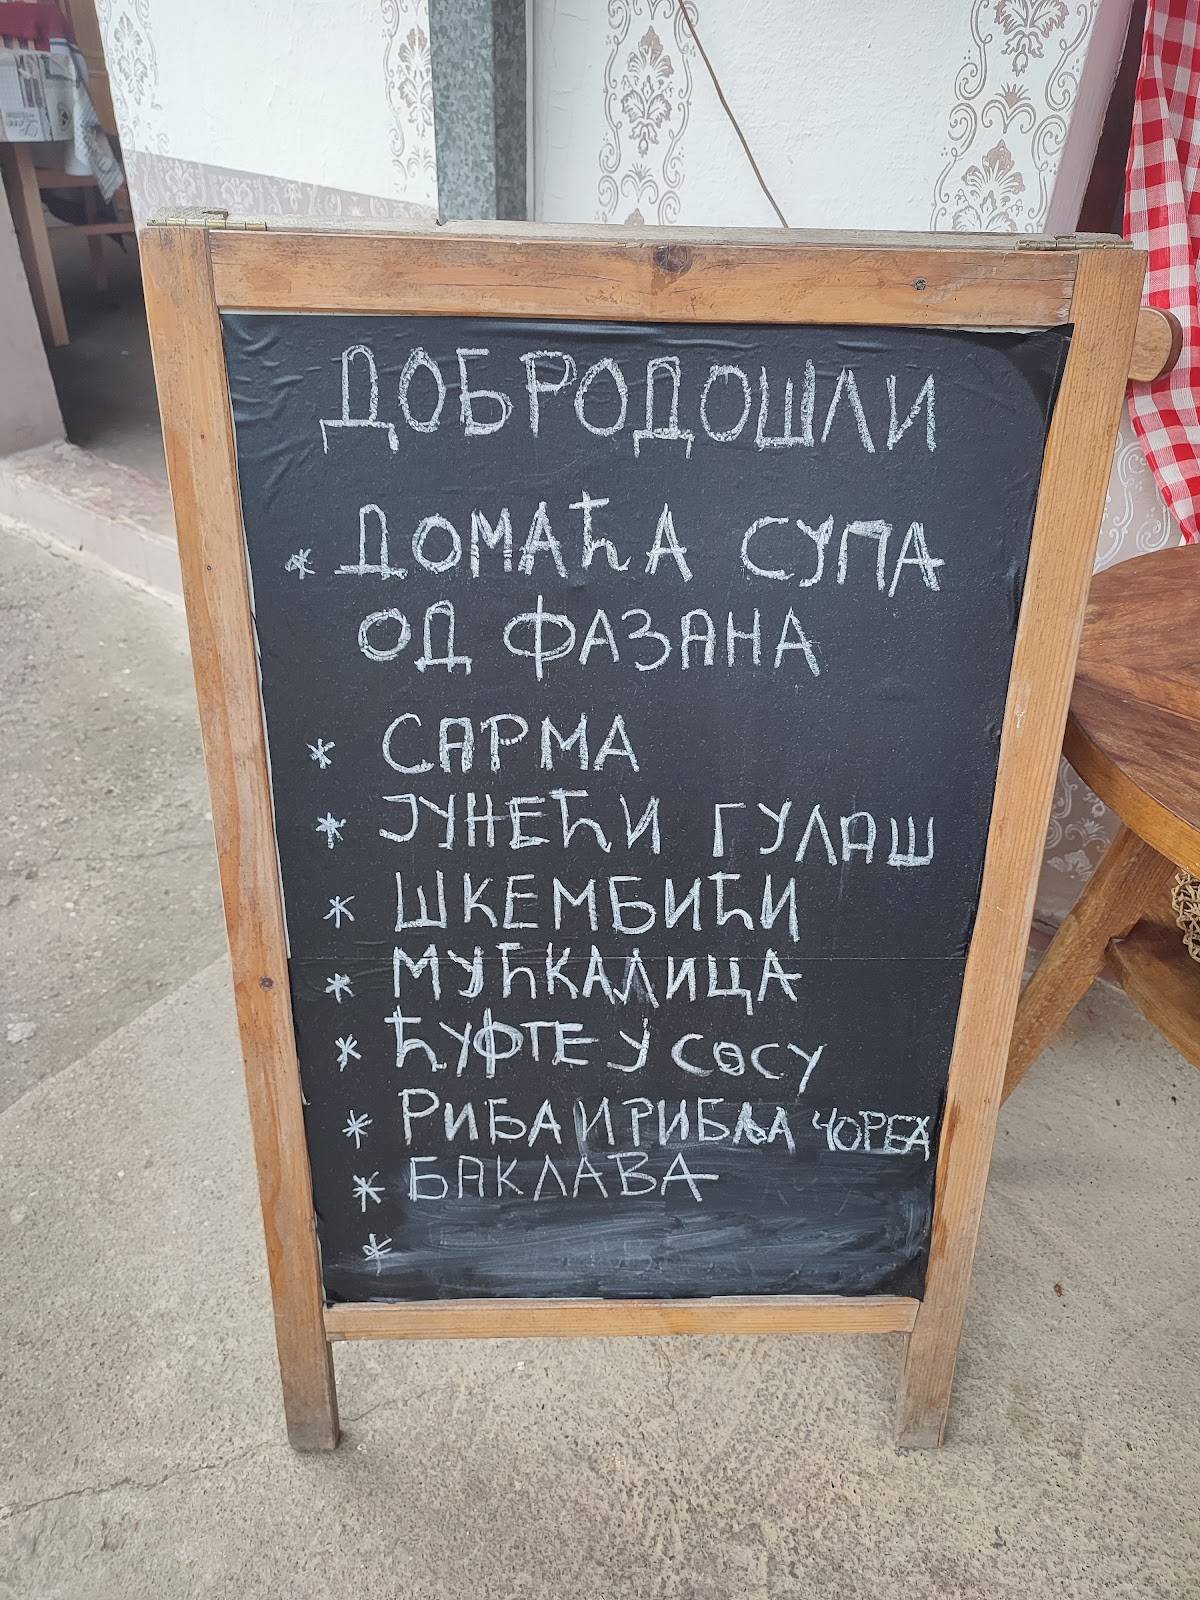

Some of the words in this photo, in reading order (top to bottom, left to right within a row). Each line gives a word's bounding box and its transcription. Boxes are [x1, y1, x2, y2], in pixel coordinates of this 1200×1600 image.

[319, 345, 937, 459] ДОБРОДОШЛИ
[333, 490, 693, 583] ДОМАЋА
[739, 513, 946, 598] СУПА
[357, 599, 473, 675] ОД
[502, 594, 820, 682] ФАЗАНА
[382, 712, 640, 774] САРМА
[378, 787, 661, 855] ЈУНЕЋИ
[712, 800, 934, 867] ГУЛАШ
[394, 870, 801, 942] ШКЕМБИЋИ
[392, 942, 802, 1015] МУЋКАЛИЦА
[384, 1005, 597, 1079] ЋУФТЕ
[607, 1017, 651, 1073] У
[671, 1033, 826, 1095] СОСУ
[397, 1088, 562, 1148] РИБА
[573, 1096, 615, 1146] И
[812, 1107, 930, 1162] ЧОРБА
[407, 1153, 720, 1202] БАКЛАВА
